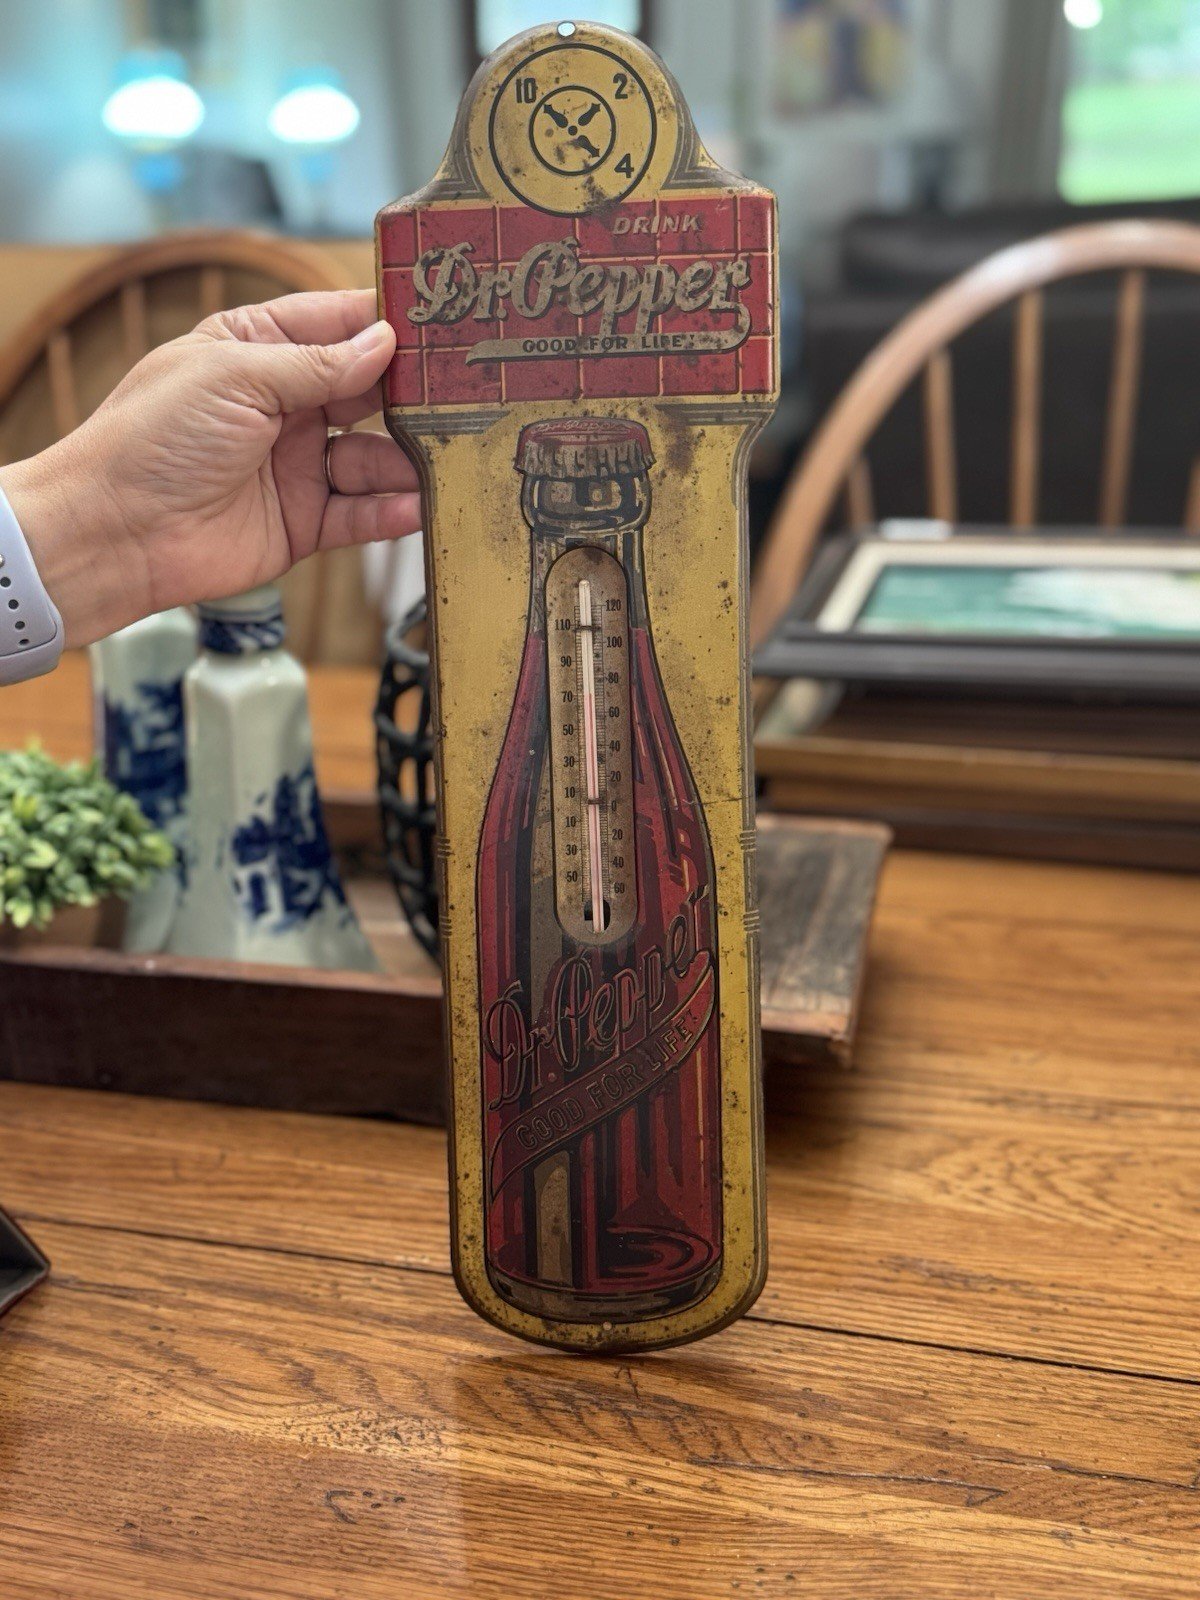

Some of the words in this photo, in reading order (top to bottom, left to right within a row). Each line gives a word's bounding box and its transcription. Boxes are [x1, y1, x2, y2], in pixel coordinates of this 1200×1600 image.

[516, 77, 537, 104] 10
[612, 73, 628, 99] 2
[614, 153, 634, 178] 4
[613, 214, 701, 235] DRINK
[510, 236, 752, 339] Pepper
[522, 338, 577, 353] GOOD
[589, 336, 628, 350] FOR
[605, 599, 622, 612] 120
[554, 619, 571, 631] 110
[606, 636, 622, 648] 100
[560, 656, 572, 667] 90
[607, 672, 619, 684] 80
[562, 691, 573, 702] 70
[608, 706, 620, 718] 60
[563, 724, 574, 736] 50
[609, 740, 621, 752] 40
[563, 756, 575, 768] 30
[610, 771, 622, 782] 20
[564, 787, 576, 799] 10
[611, 801, 617, 812] 0
[565, 816, 577, 828] 10
[612, 829, 623, 841] 20
[565, 844, 578, 856] 30
[612, 857, 624, 868] 40
[566, 871, 578, 883] 50
[614, 882, 625, 894] 60
[515, 1096, 585, 1150] GOOD
[585, 1063, 644, 1109] FOR
